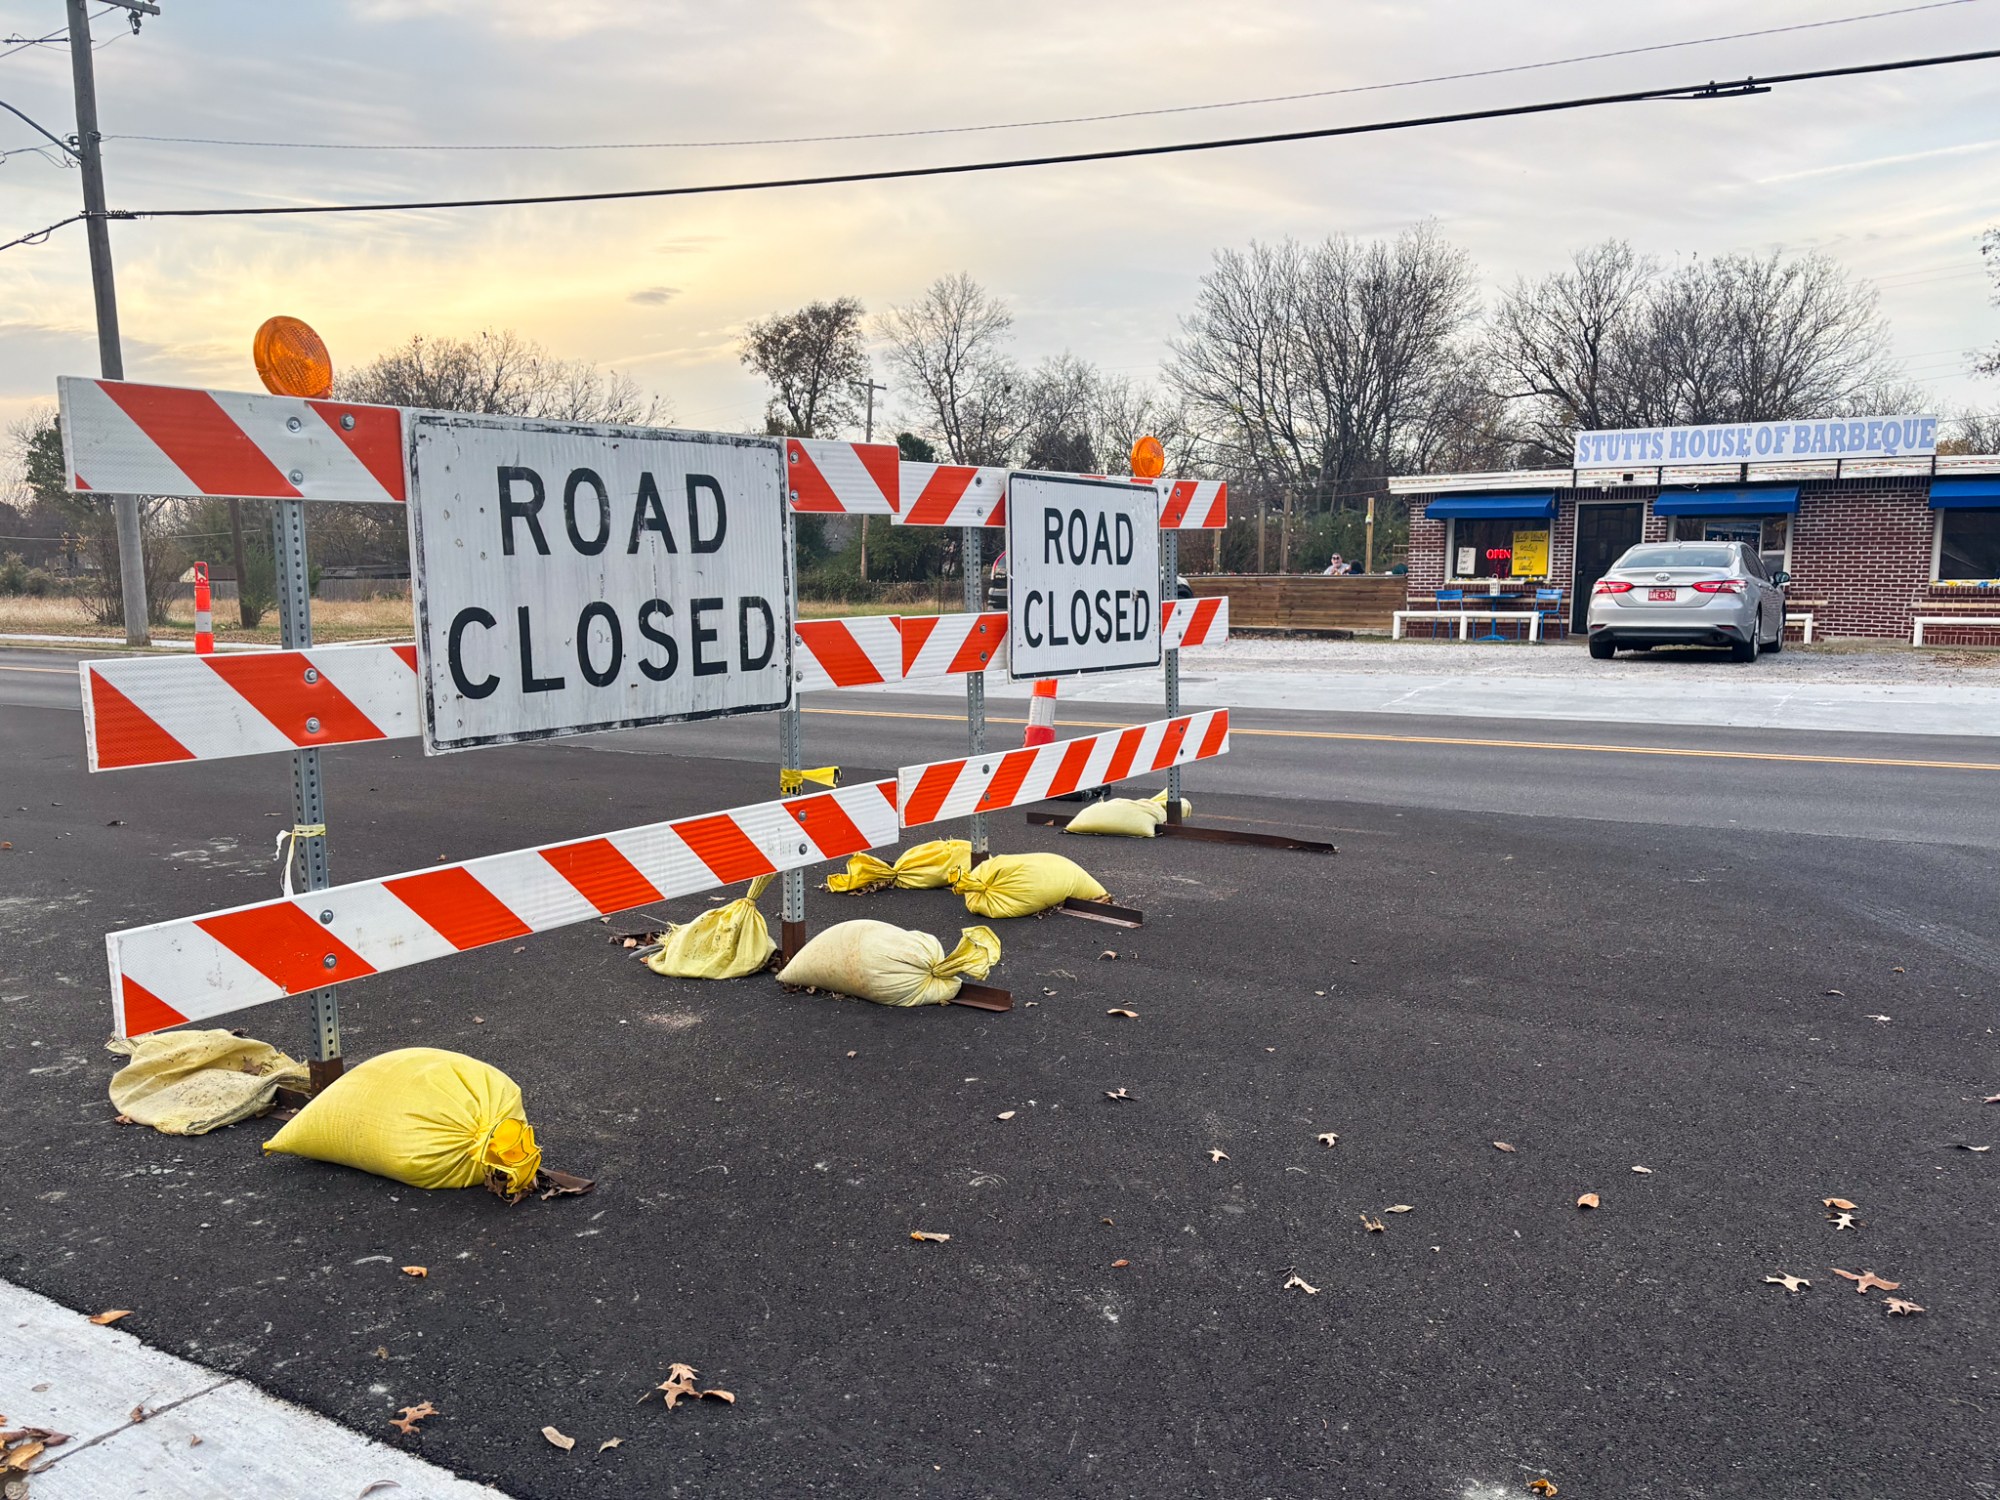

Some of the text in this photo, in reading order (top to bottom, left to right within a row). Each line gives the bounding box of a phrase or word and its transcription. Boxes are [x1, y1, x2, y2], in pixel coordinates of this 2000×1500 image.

[1578, 418, 1937, 462] STUTTS HOUSE OF BARBEQUE
[497, 466, 727, 556] ROAD
[1044, 507, 1134, 566] ROAD
[1486, 548, 1511, 560] OPEN
[448, 596, 775, 700] CLOSED
[1024, 589, 1150, 648] CLOSED
